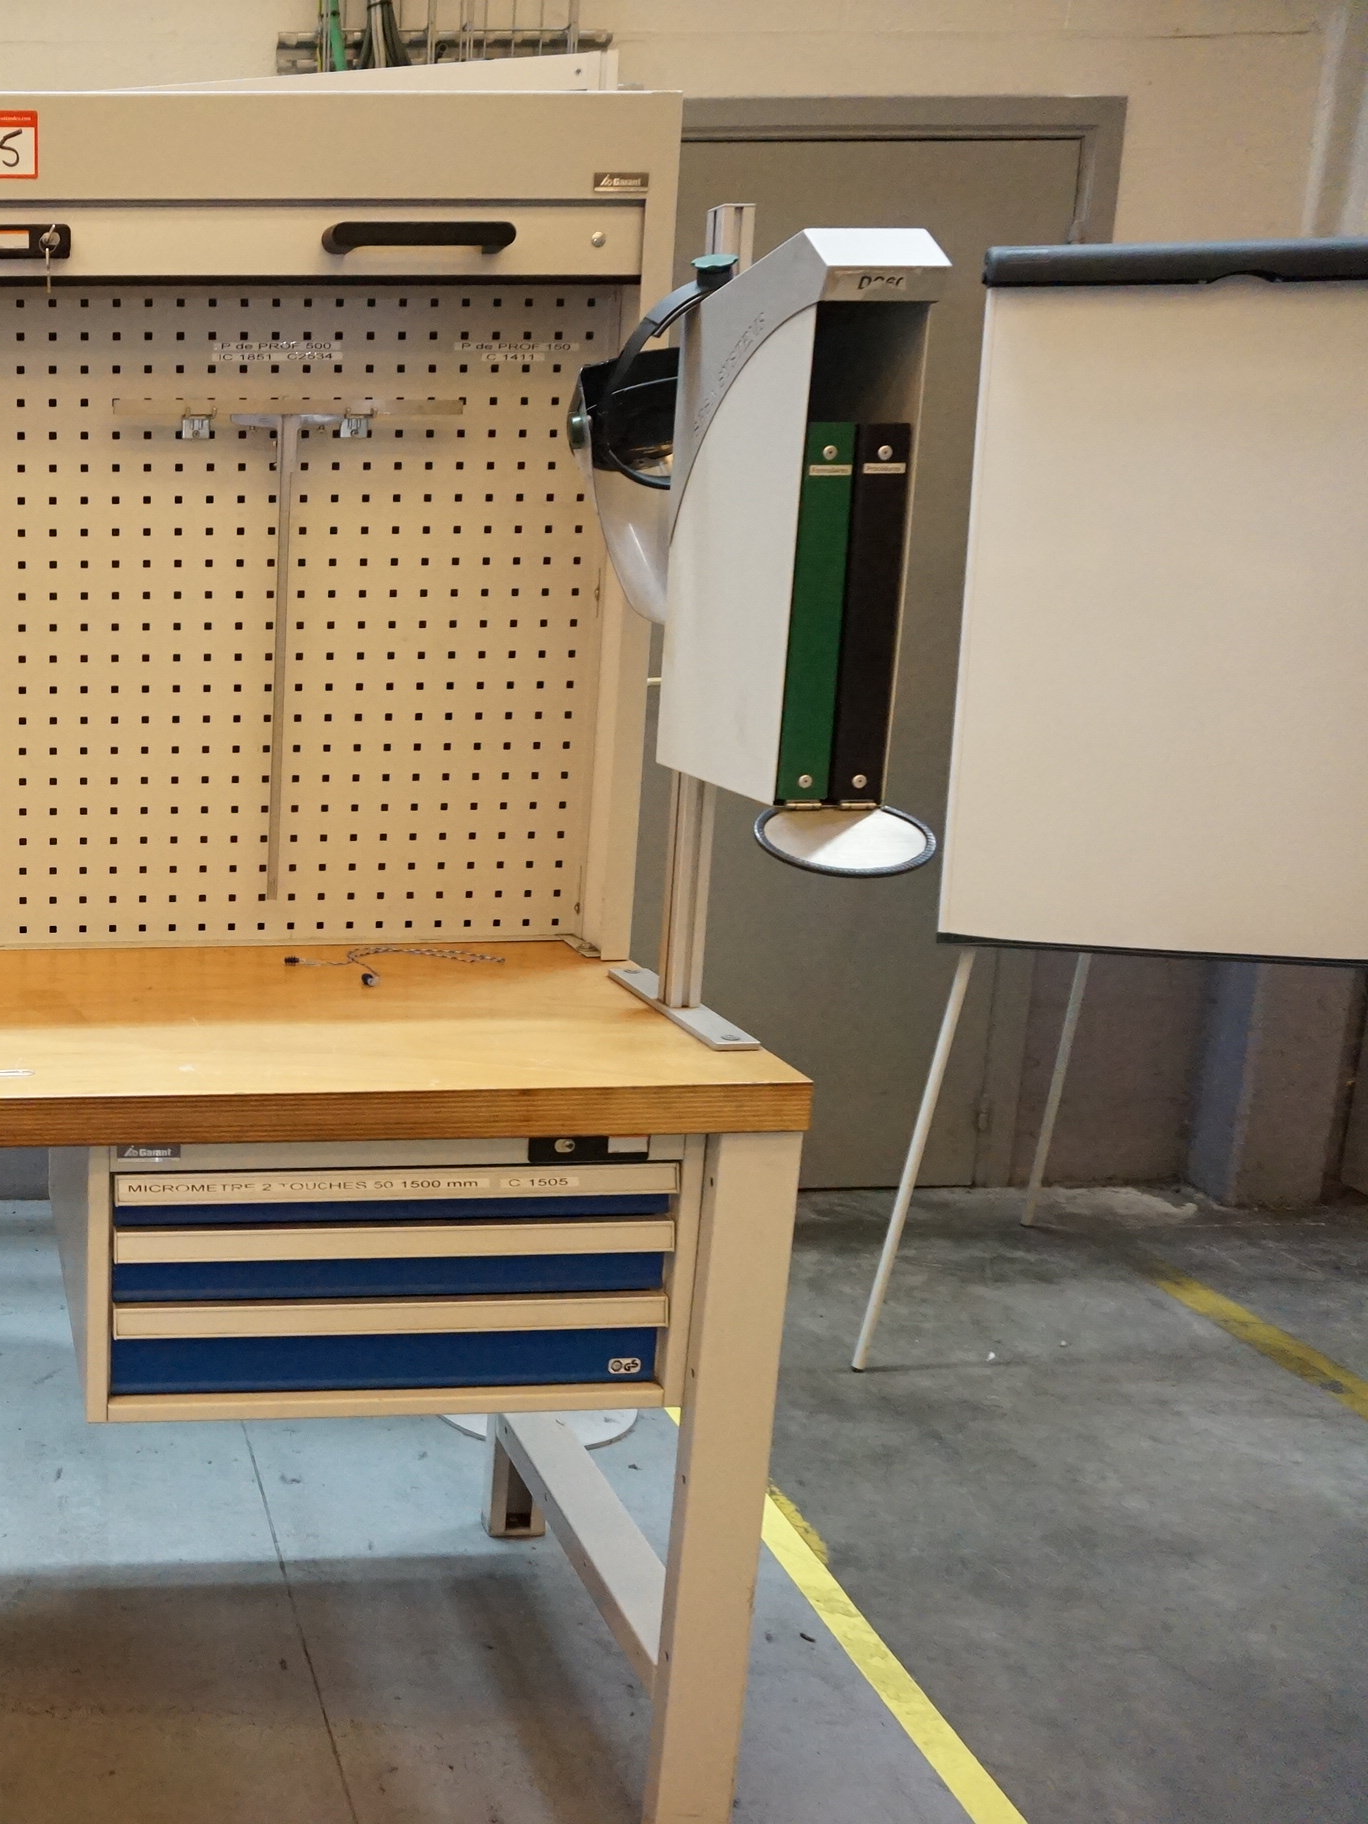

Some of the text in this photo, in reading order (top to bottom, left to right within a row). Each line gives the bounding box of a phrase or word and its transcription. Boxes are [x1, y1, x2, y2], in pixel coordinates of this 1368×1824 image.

[220, 342, 333, 350] P de PROF 500
[460, 342, 471, 350] P
[475, 342, 493, 350] de
[547, 343, 571, 351] 150
[239, 353, 272, 361] 1851
[486, 353, 497, 361] C
[139, 1147, 173, 1158] Garant
[262, 1183, 272, 1192] 2
[374, 1180, 395, 1190] 50
[401, 1179, 442, 1189] 1500
[446, 1179, 479, 1188] mm
[508, 1178, 521, 1188] C
[529, 1177, 569, 1187] 1505
